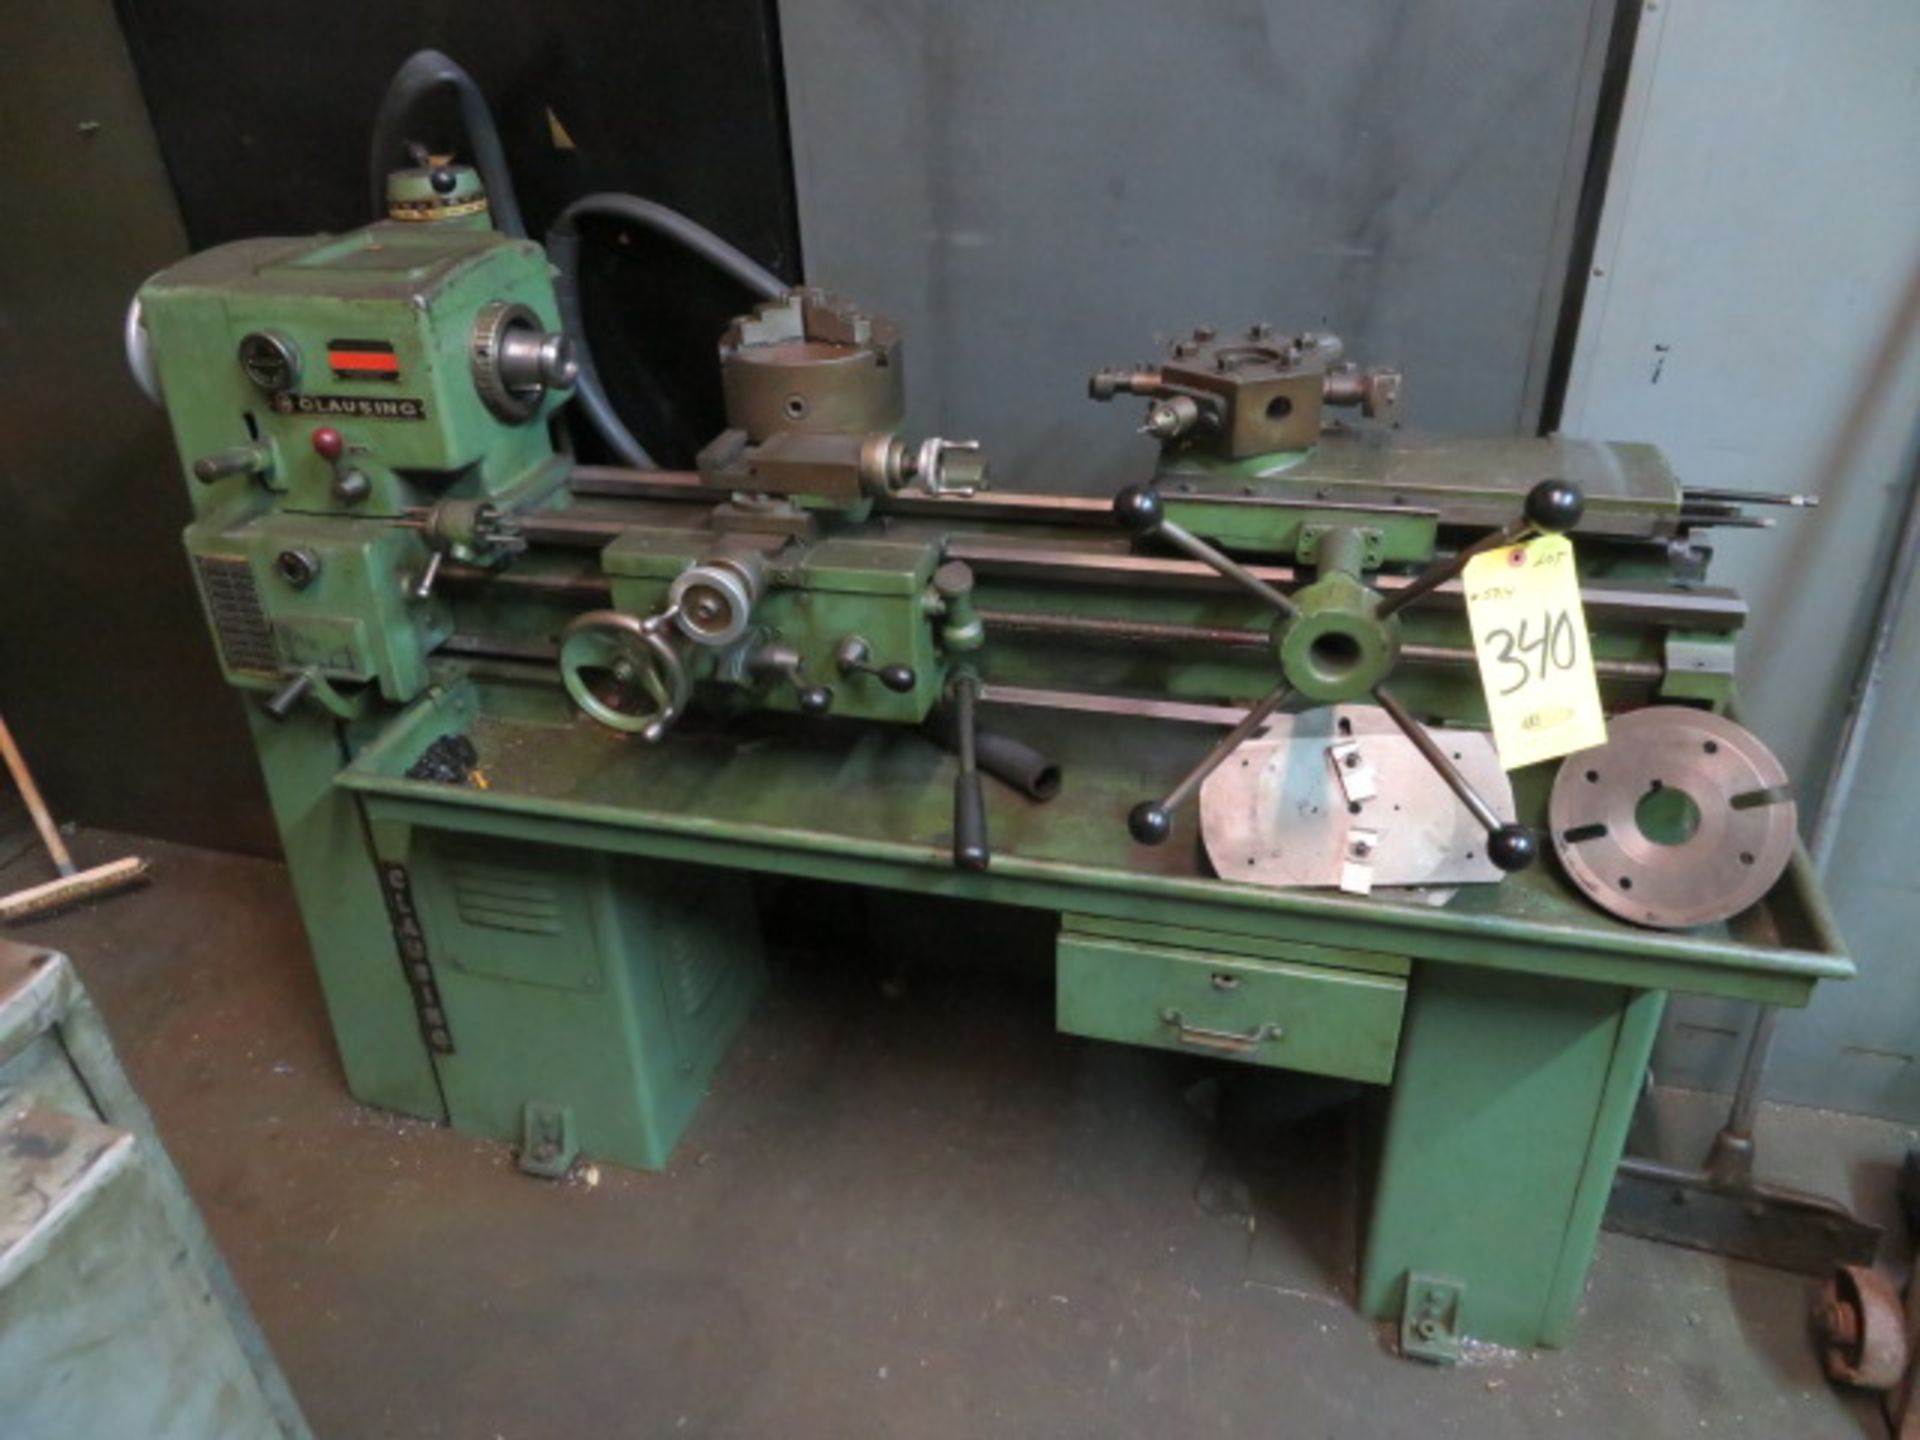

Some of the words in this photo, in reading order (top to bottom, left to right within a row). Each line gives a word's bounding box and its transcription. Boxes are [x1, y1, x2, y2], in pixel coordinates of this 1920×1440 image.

[299, 396, 418, 416] CLAUSING
[1484, 608, 1577, 697] 340
[387, 866, 451, 1048] CLAUSING
